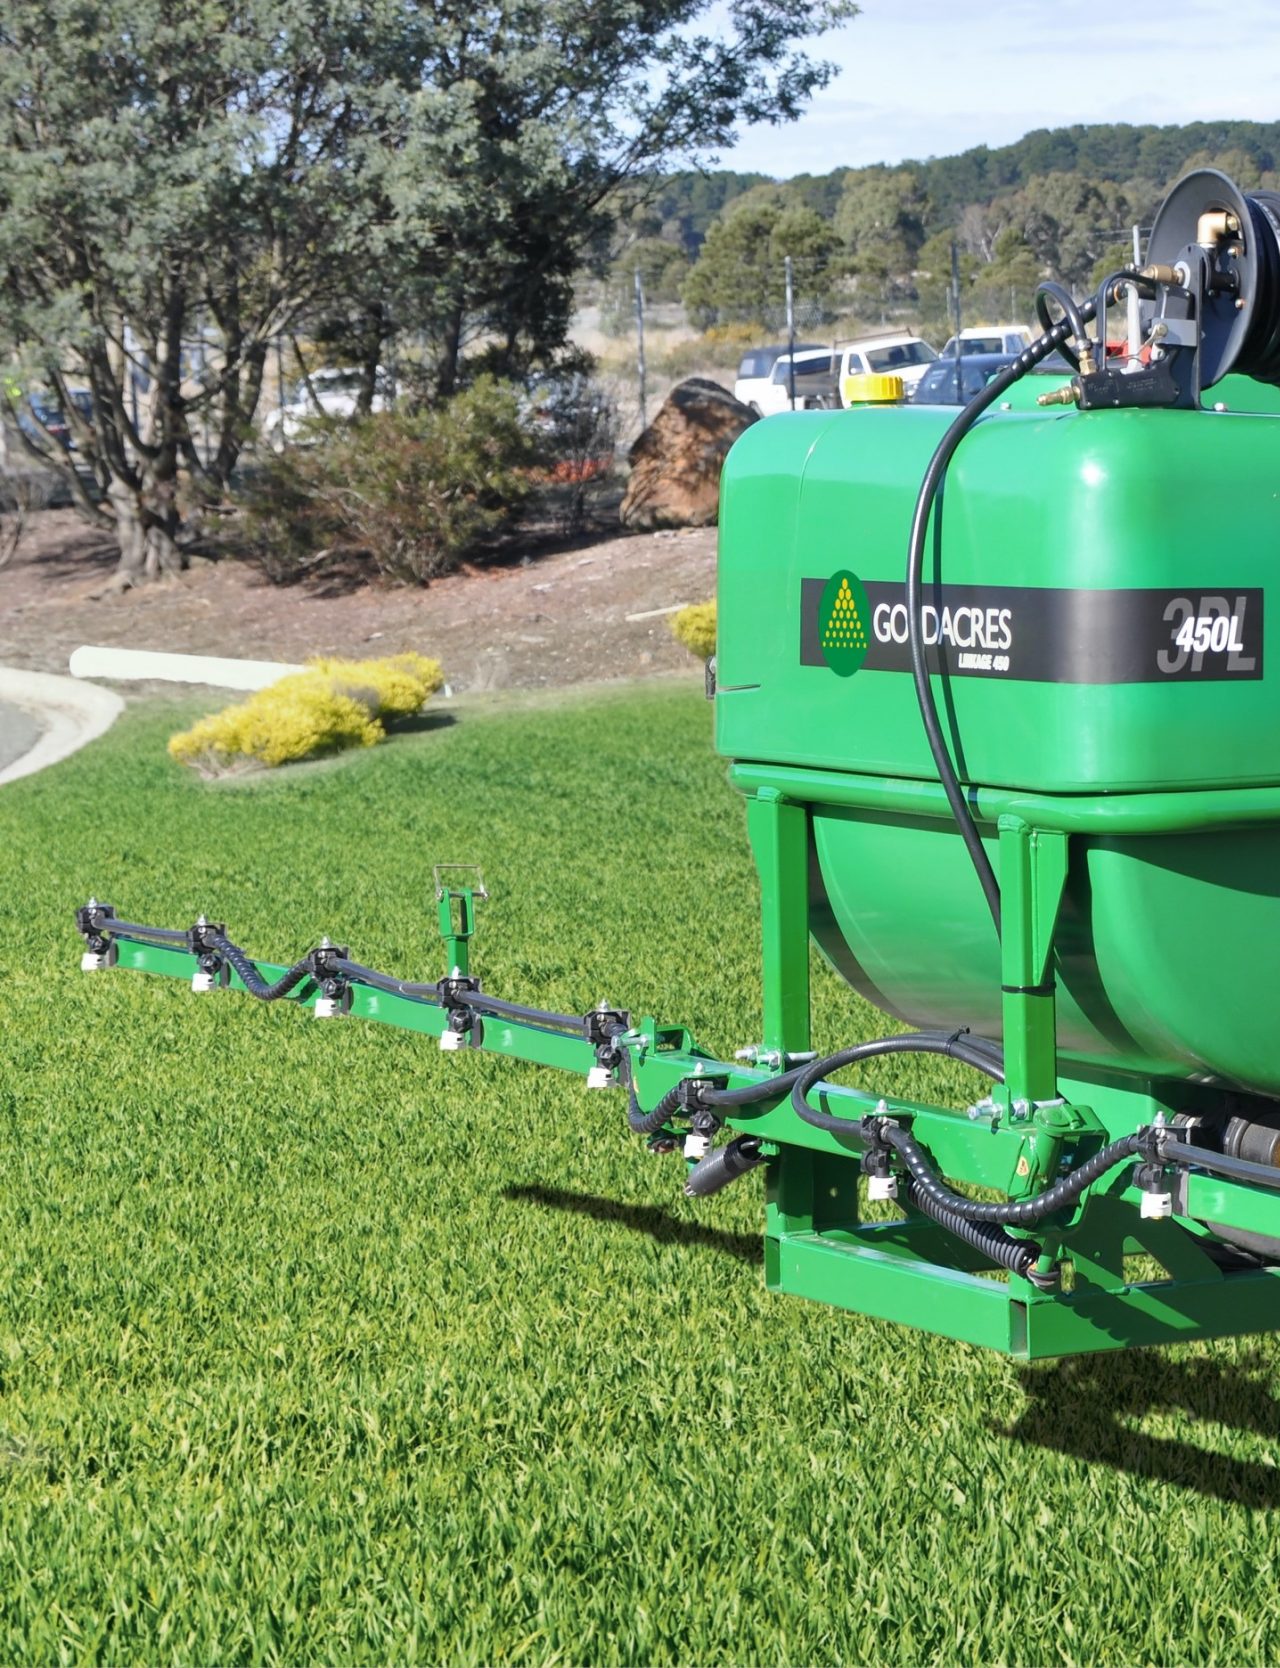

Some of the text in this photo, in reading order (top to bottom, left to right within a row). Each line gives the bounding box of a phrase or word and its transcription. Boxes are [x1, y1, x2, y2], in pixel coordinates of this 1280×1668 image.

[873, 603, 1012, 650] GODACRES
[1156, 595, 1256, 674] 3PL
[1175, 615, 1244, 653] 450L
